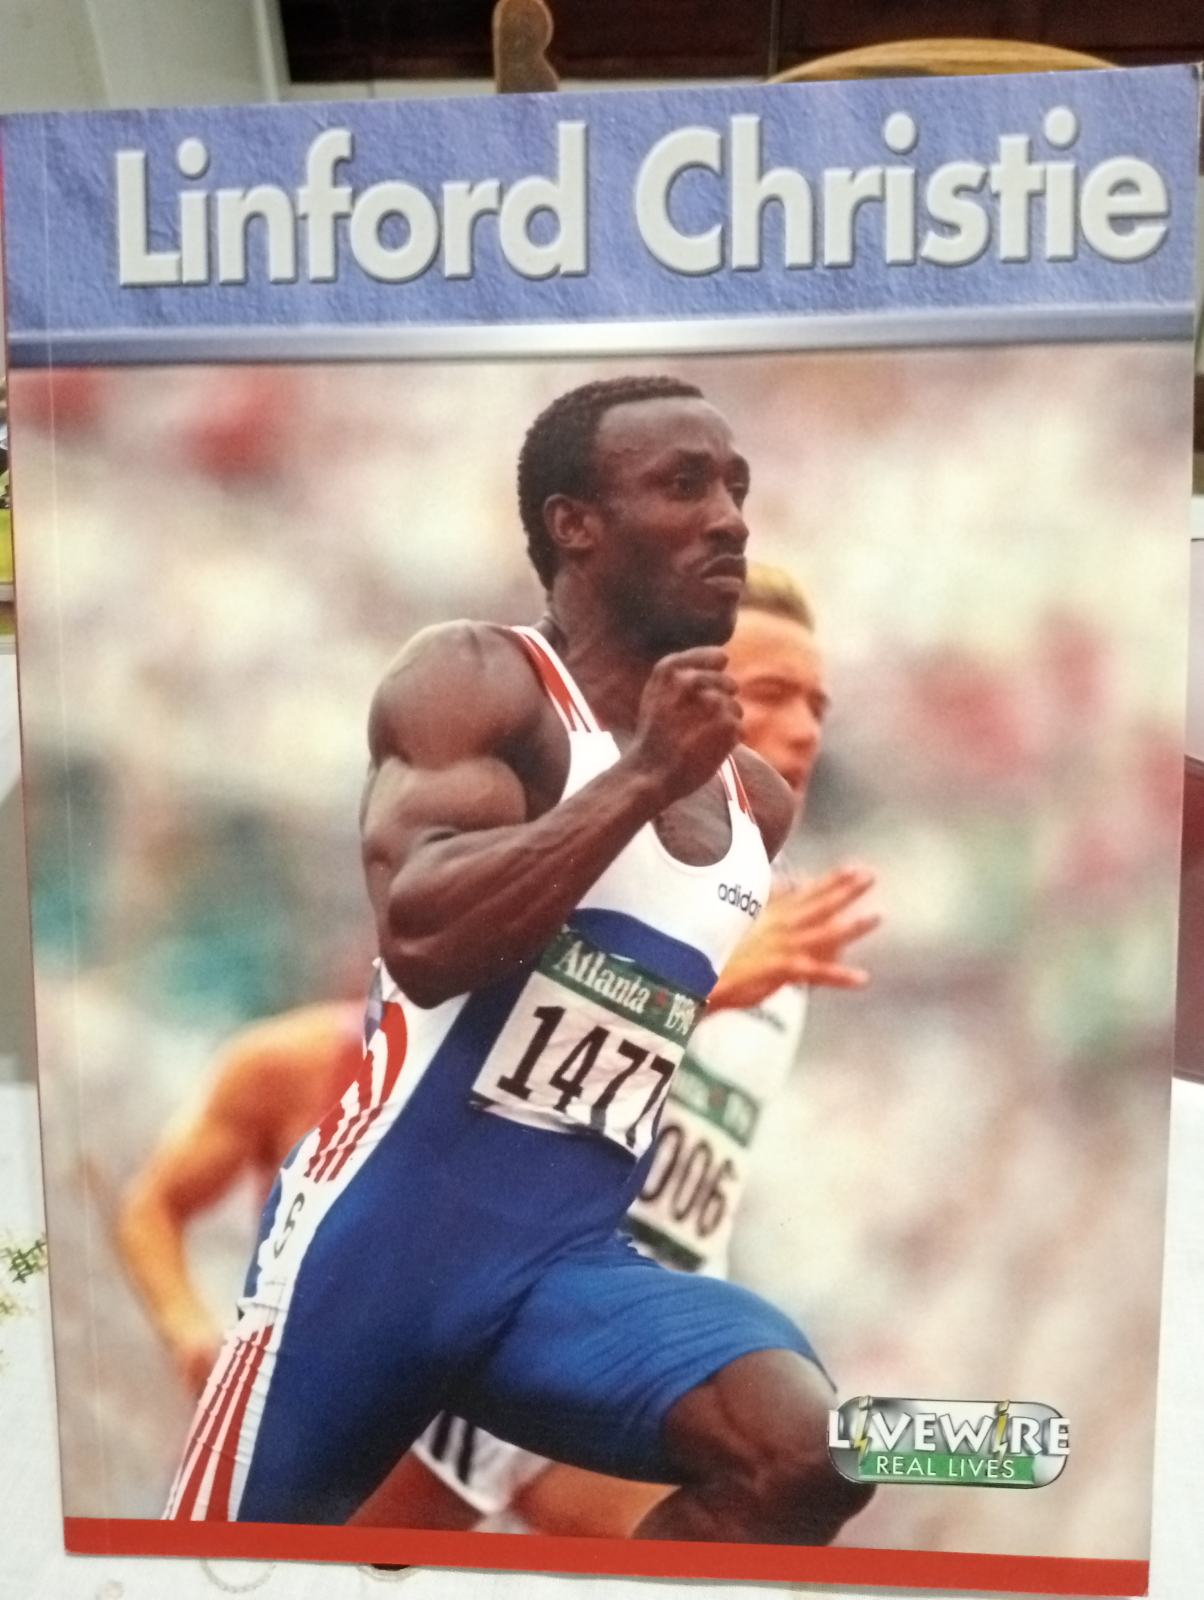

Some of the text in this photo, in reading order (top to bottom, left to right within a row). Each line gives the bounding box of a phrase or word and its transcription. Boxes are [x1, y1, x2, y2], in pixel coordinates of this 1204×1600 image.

[115, 107, 1169, 285] Linford Christie
[554, 941, 652, 1014] Atlanta
[496, 1006, 676, 1148] 1477
[876, 1456, 1015, 1478] REAL LIVES
